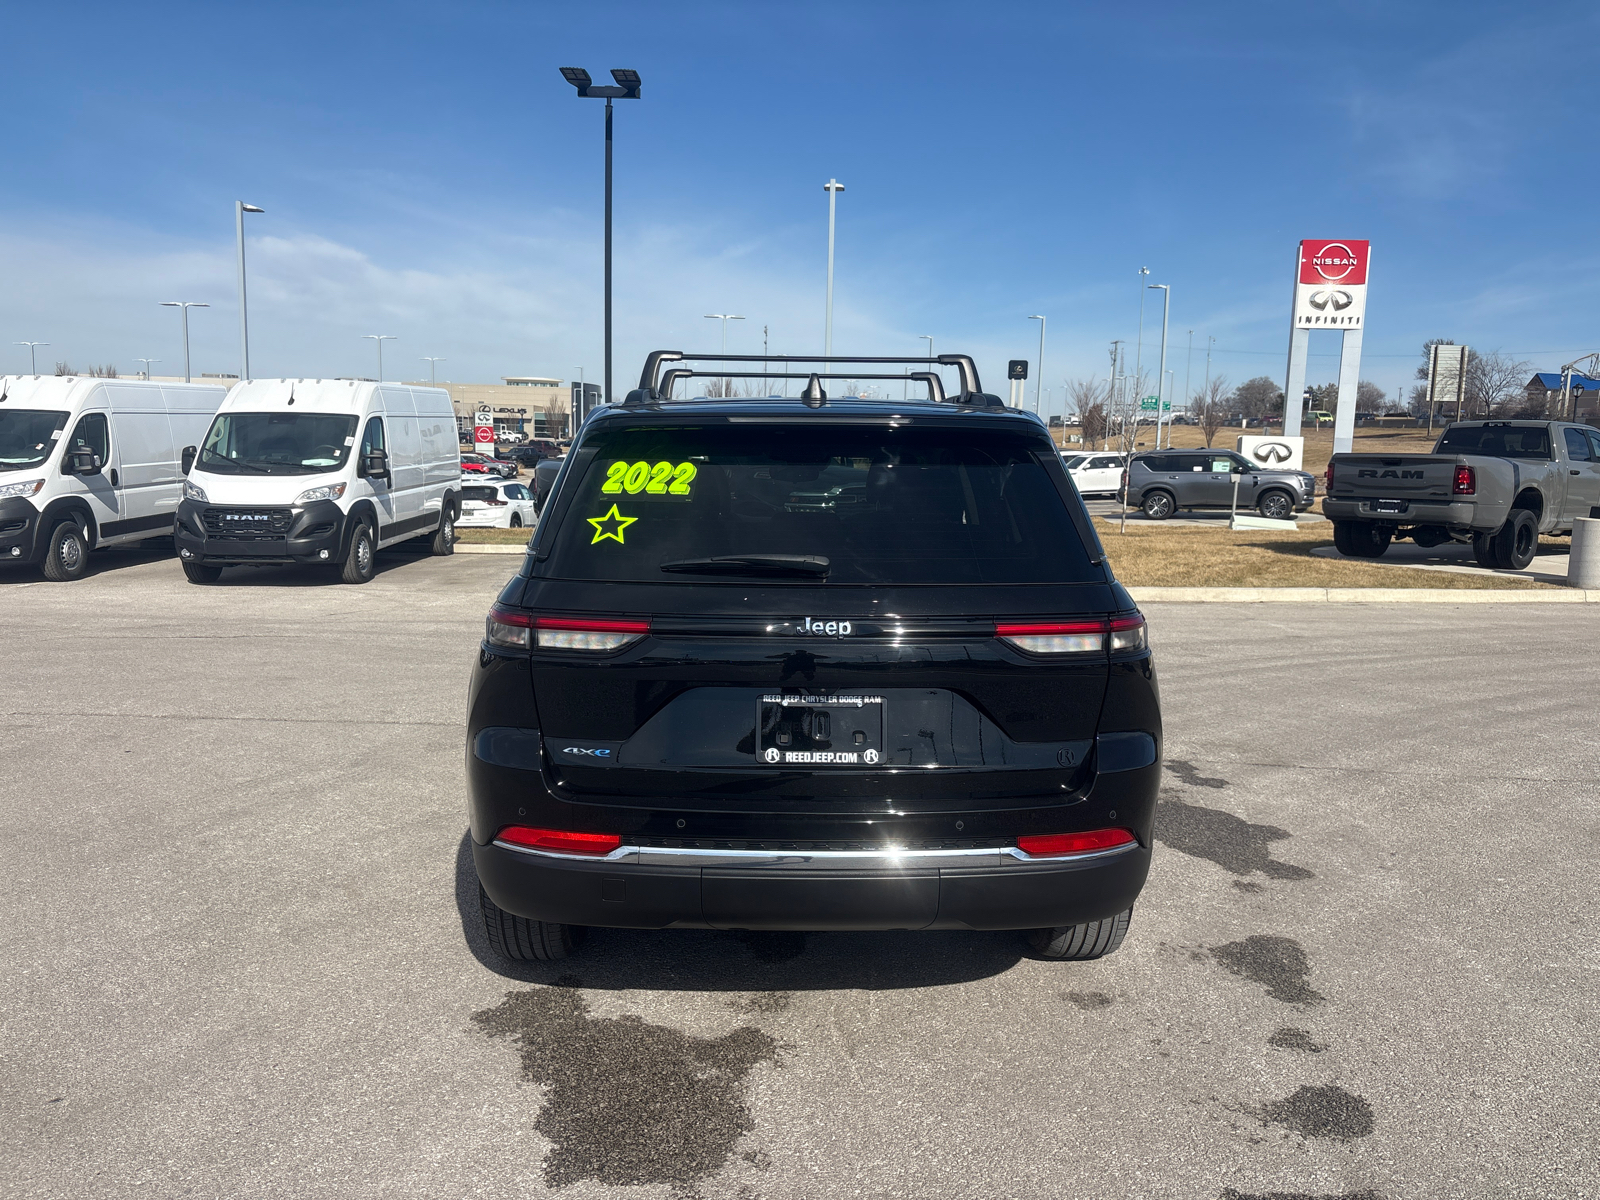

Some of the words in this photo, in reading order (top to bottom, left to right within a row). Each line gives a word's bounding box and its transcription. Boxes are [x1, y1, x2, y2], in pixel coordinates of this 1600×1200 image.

[1312, 258, 1357, 266] NISSAN
[1298, 316, 1360, 325] INFINITI
[601, 461, 697, 495] 2022
[1357, 469, 1425, 480] RAM
[796, 617, 851, 640] Jeep
[763, 694, 781, 702] REED
[801, 695, 838, 703] CHRYSLER
[839, 696, 863, 704] DODGE
[864, 696, 881, 704] RAM
[785, 752, 858, 764] REEDJEEP.COM
